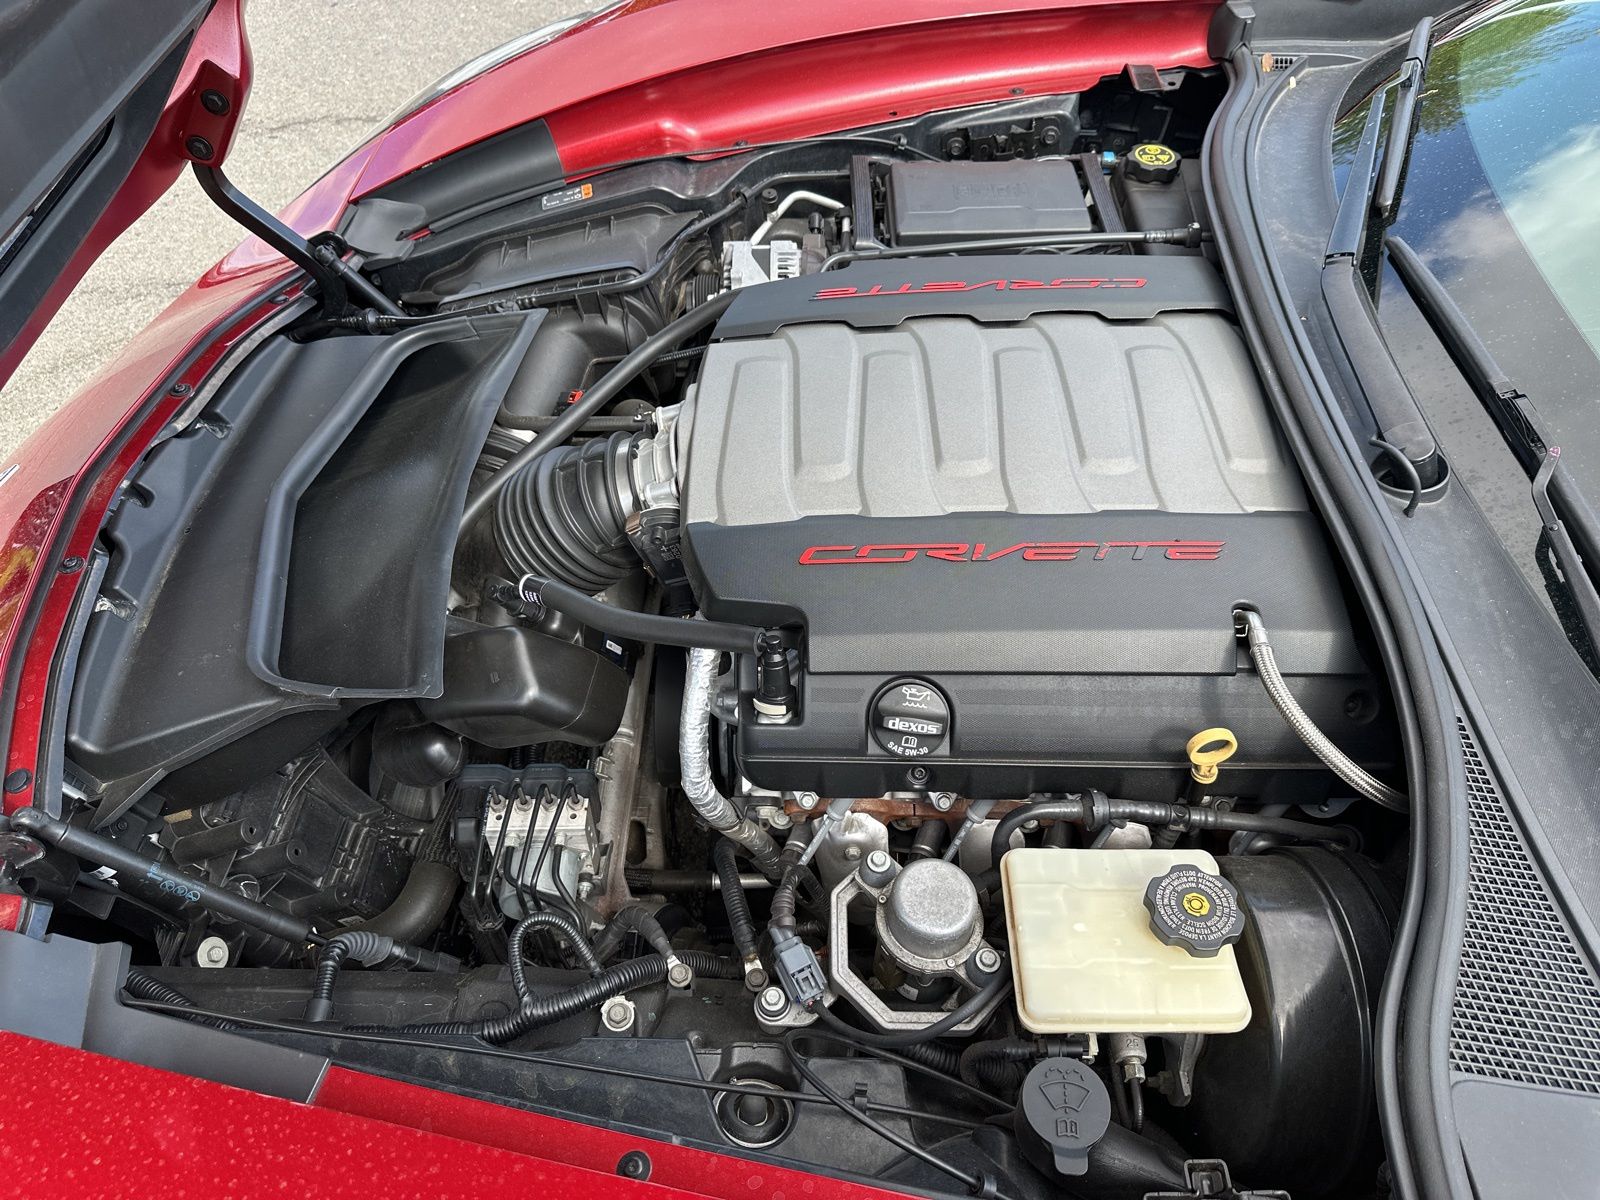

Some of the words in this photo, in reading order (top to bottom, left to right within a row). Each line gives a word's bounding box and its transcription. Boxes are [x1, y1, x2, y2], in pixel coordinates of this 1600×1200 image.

[813, 278, 1148, 300] CORVETTE
[799, 540, 1227, 564] CORVETTE
[888, 717, 940, 734] dexos
[887, 741, 903, 755] SAE
[904, 746, 929, 756] 5W-30
[1126, 1038, 1139, 1048] 25
